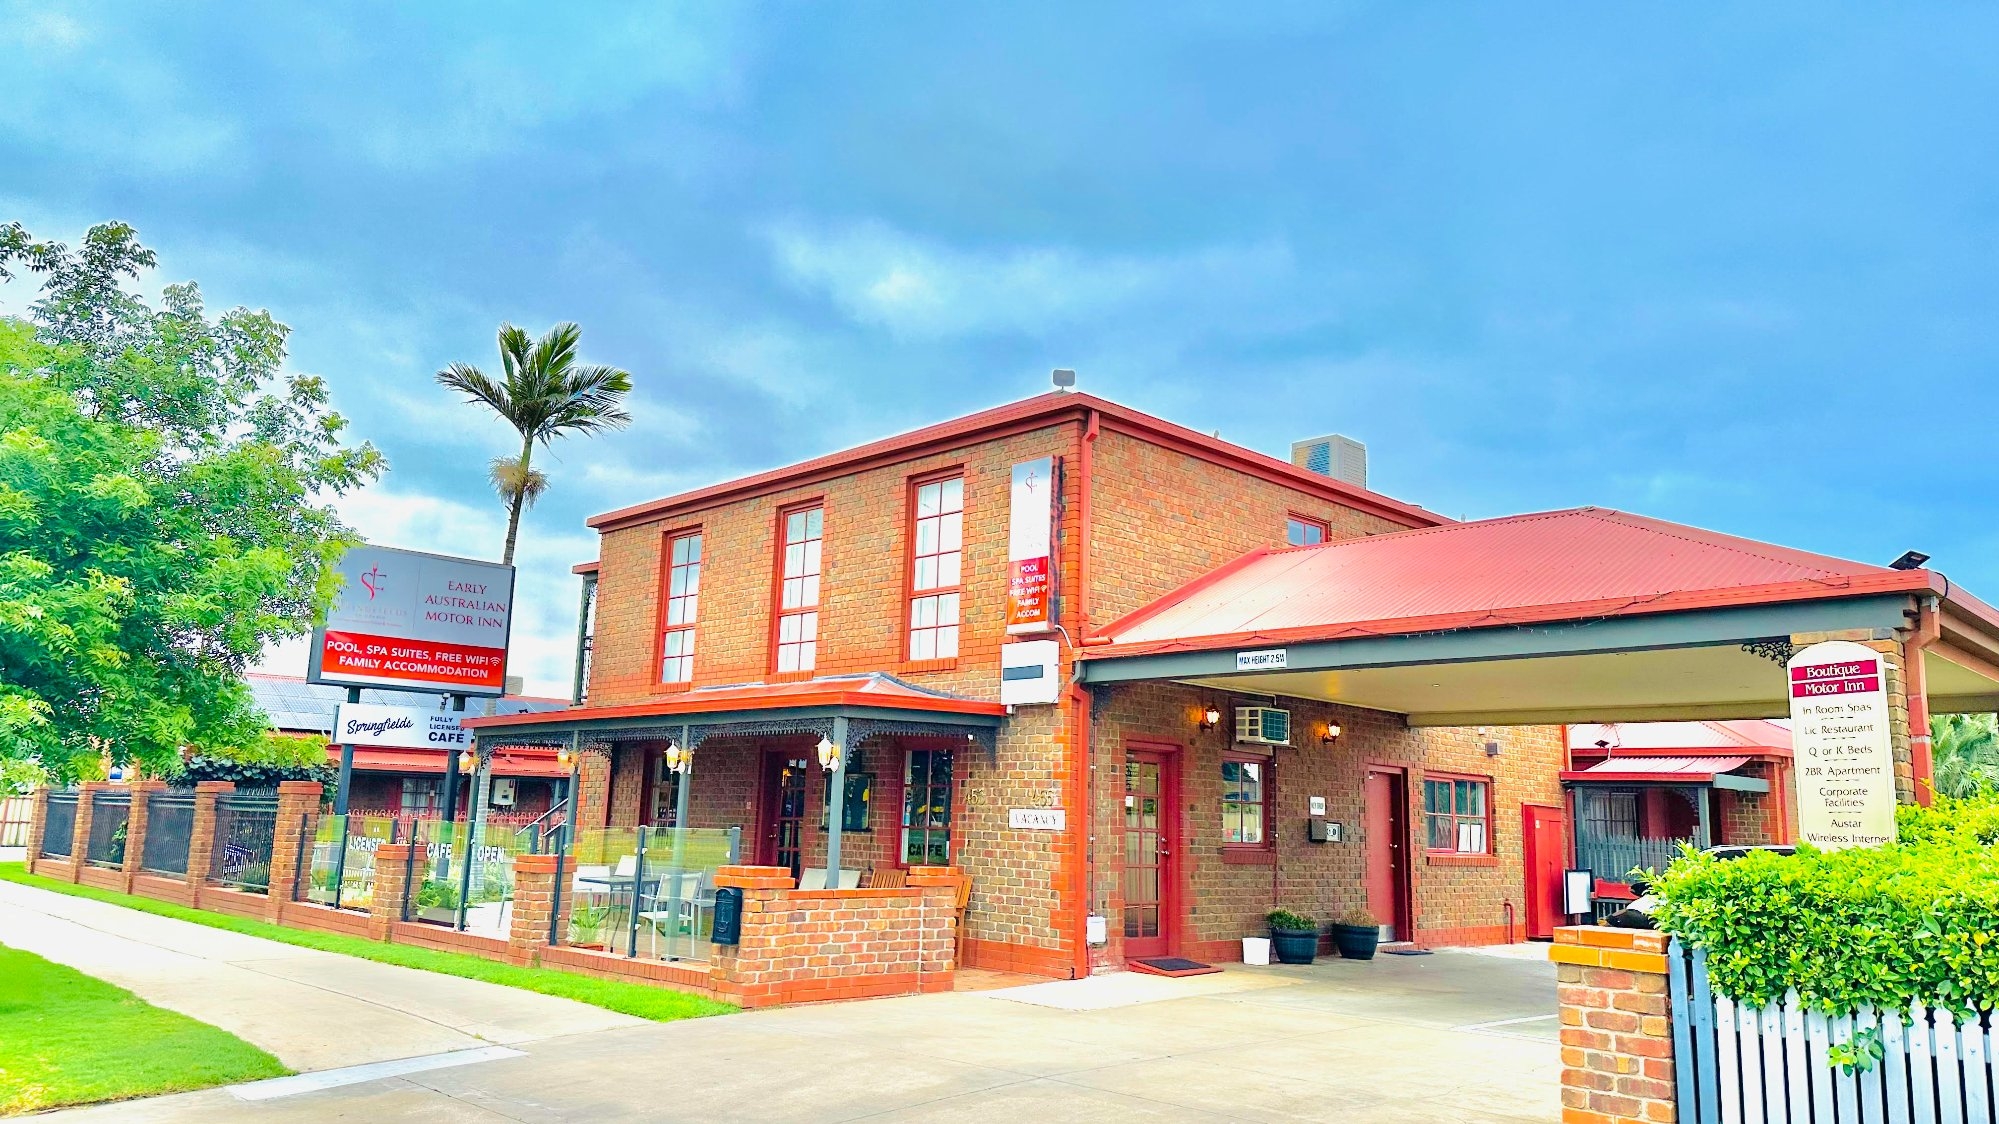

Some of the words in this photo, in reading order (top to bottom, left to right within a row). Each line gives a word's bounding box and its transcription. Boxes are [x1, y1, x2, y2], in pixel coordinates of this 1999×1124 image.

[1020, 564, 1038, 573] POOL
[1011, 577, 1024, 586] SPA
[1025, 574, 1046, 583] SUITES
[448, 580, 488, 595] EARLY
[425, 594, 506, 613] AUSTRALIAN
[1017, 598, 1040, 607] FAMILY
[425, 611, 474, 626] MOTOR
[478, 616, 503, 628] INN
[1016, 609, 1041, 618] ACCOM
[327, 640, 363, 655] POOL,
[366, 644, 388, 656] SPA
[391, 647, 432, 662] SUITES,
[435, 652, 462, 664] FREE
[465, 654, 489, 666] WIFI
[1239, 656, 1251, 665] MAX
[1252, 654, 1270, 664] HEIGHT
[339, 656, 381, 670] FAMILY
[383, 661, 489, 679] ACCOMMODATION
[1806, 662, 1861, 680] Boutique
[1805, 682, 1840, 695] Motor
[1844, 680, 1865, 692] Inn
[1803, 706, 1812, 715] In
[1815, 703, 1844, 714] Room
[1847, 702, 1872, 714] Spas
[347, 715, 414, 737] Springfields
[1804, 725, 1817, 735] Lic
[1821, 724, 1874, 734] Restaurant
[1808, 746, 1818, 758] Q
[1822, 748, 1832, 756] or
[1836, 745, 1843, 755] K
[1847, 744, 1873, 755] Beds
[1805, 766, 1822, 776] 2BR
[1827, 765, 1881, 777] Apartment
[1819, 787, 1869, 798] Corporate
[1825, 798, 1865, 807] Facilities
[1015, 813, 1057, 825] VACANCY
[1830, 818, 1862, 828] Austar
[1807, 832, 1849, 843] Wireless
[1852, 833, 1890, 844] Internet
[426, 842, 453, 858] CAFE
[477, 845, 506, 863] OPEN
[908, 843, 943, 857] CAFE
